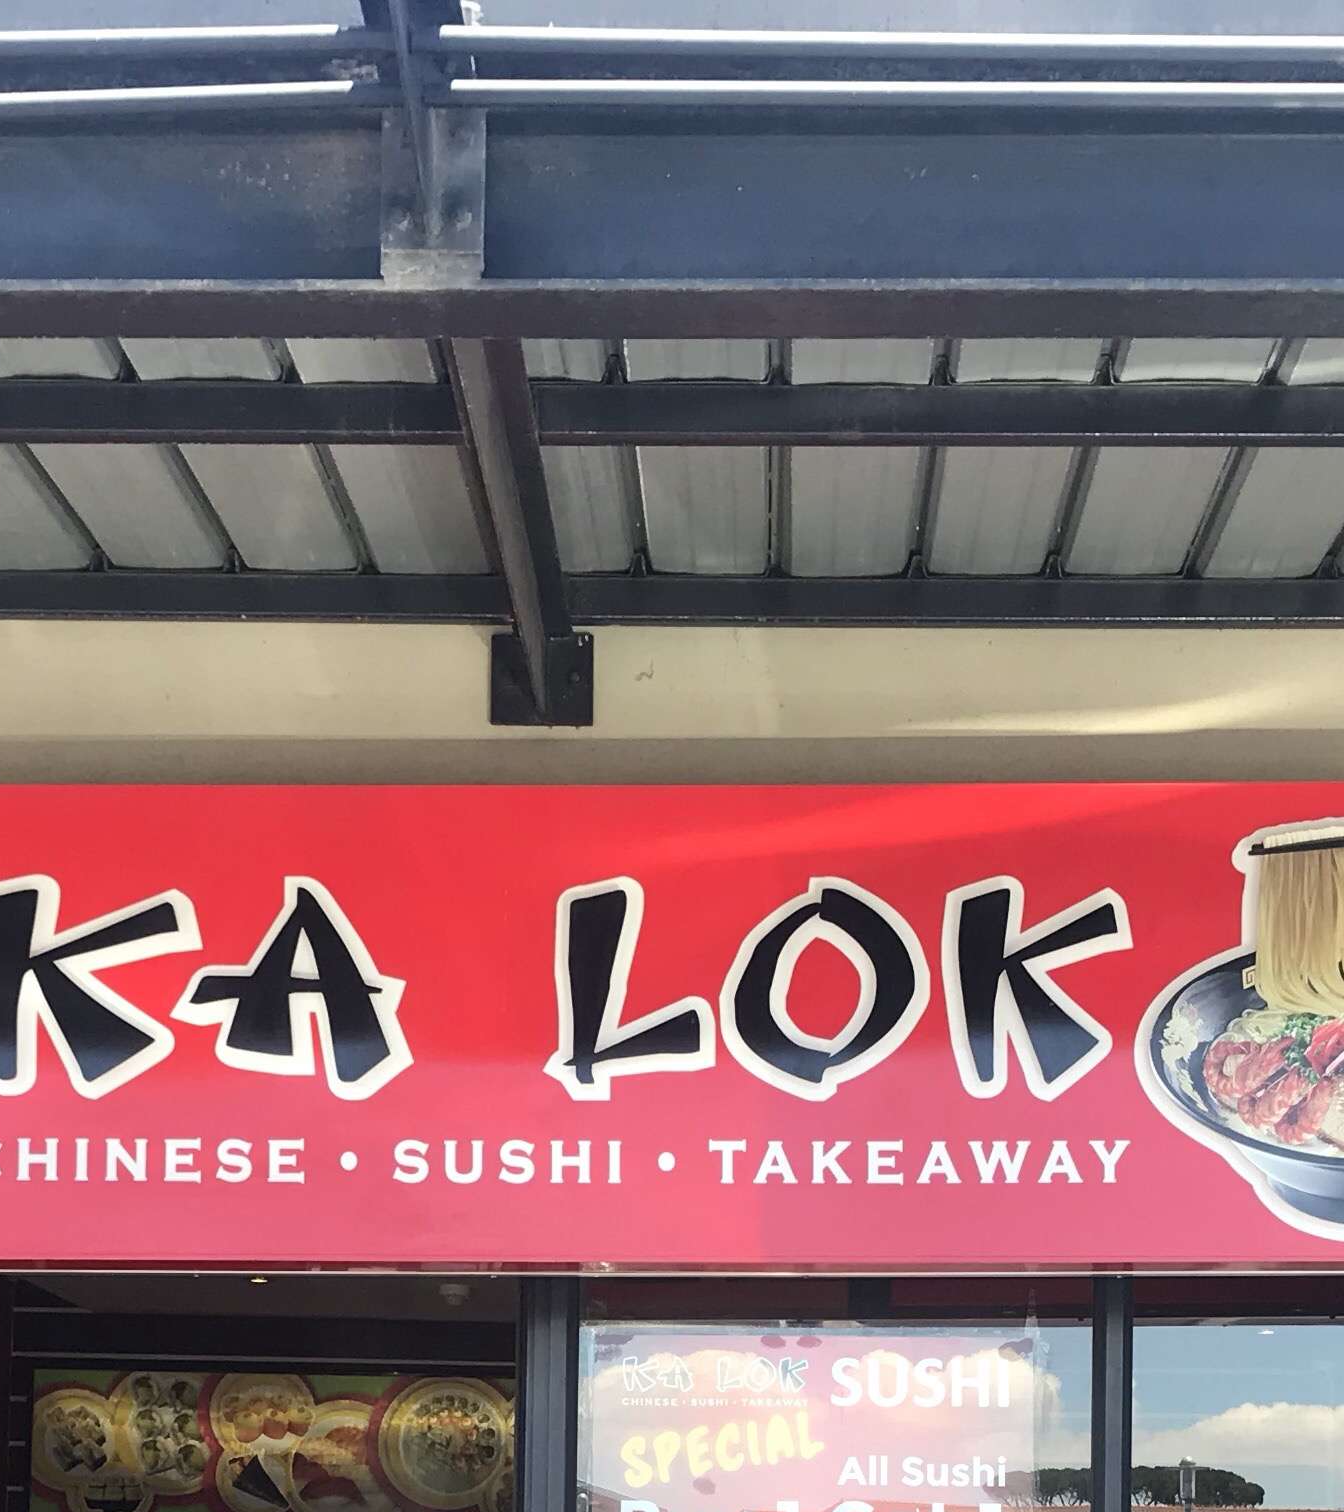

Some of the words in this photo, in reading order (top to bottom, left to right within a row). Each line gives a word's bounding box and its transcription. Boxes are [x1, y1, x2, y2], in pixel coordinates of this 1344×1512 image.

[543, 876, 1135, 1102] LOK
[393, 1139, 624, 1185] SUSHI
[708, 1138, 1132, 1186] TAKEAWAY
[622, 1356, 694, 1393] KA
[717, 1355, 808, 1393] LOK
[830, 1357, 1010, 1409] SUSHI
[621, 1397, 679, 1408] CHINESE
[620, 1410, 825, 1489] SPECIAL
[837, 1456, 888, 1487] All
[901, 1456, 1007, 1488] Sushi
